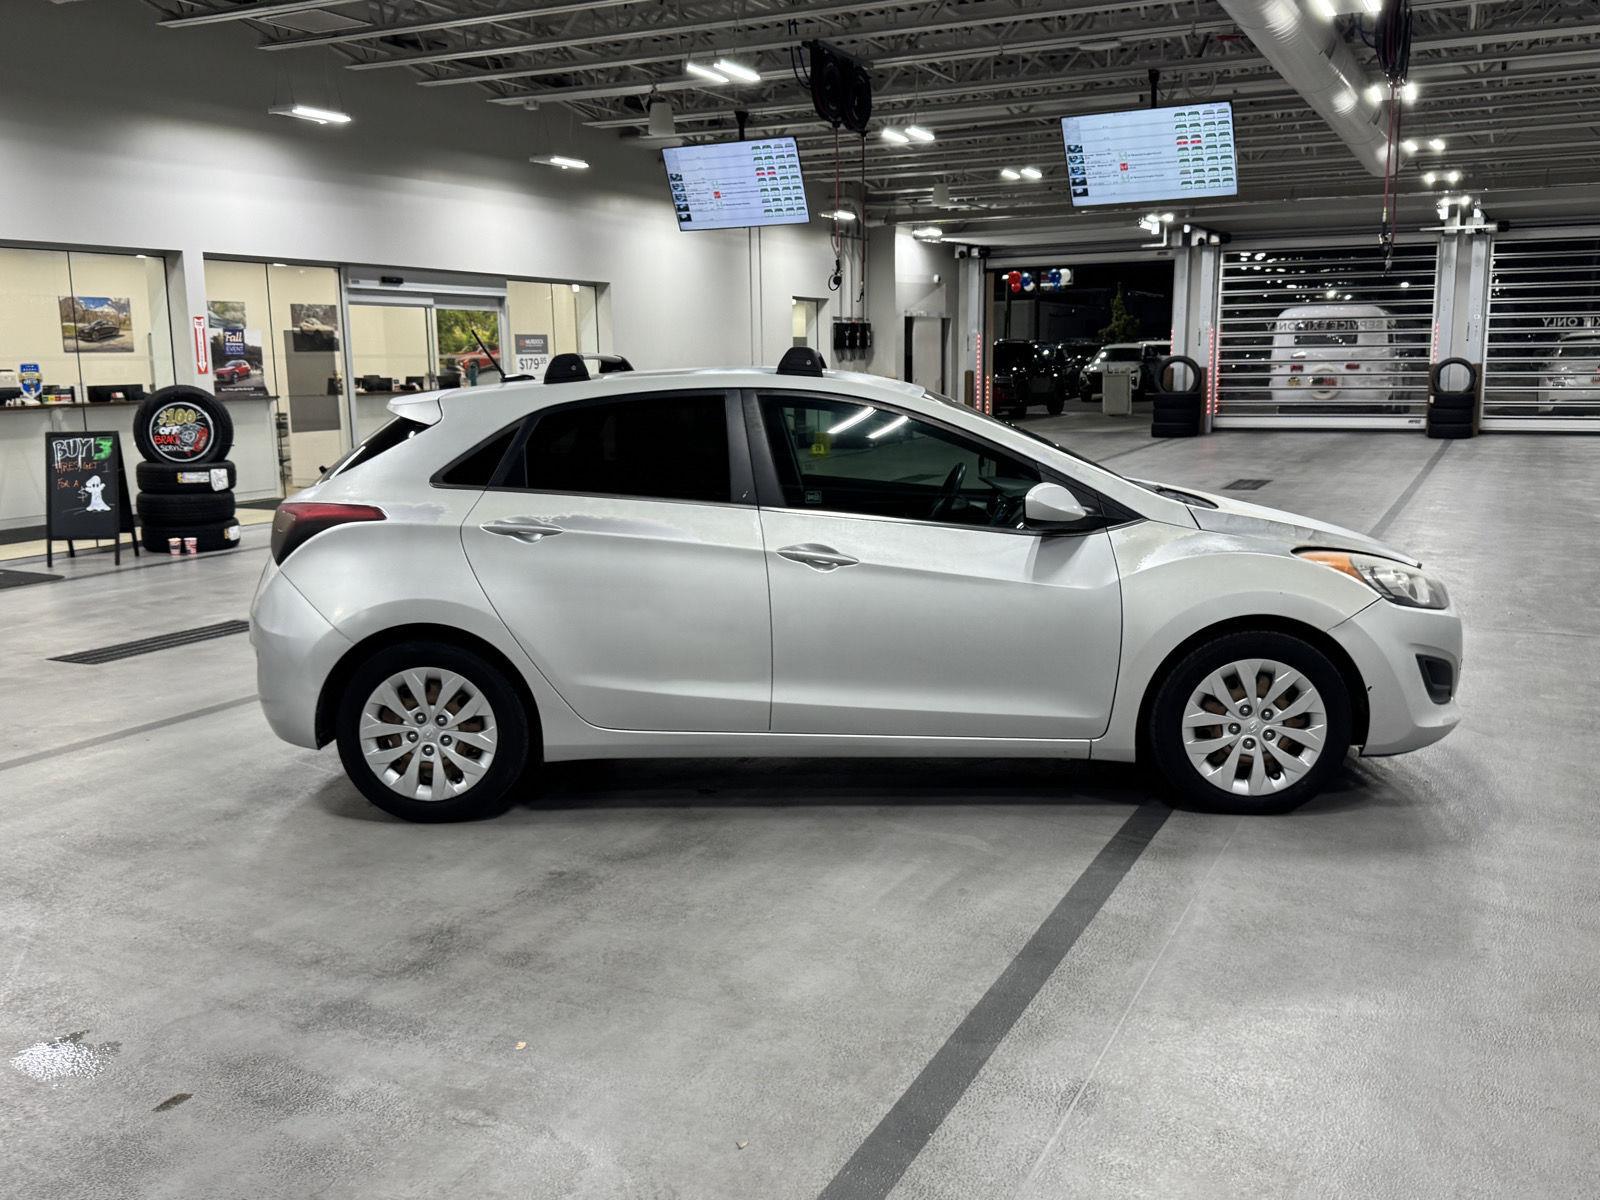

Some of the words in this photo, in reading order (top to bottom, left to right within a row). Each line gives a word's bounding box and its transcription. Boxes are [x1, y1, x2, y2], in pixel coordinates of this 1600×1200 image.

[224, 331, 243, 343] Fall
[158, 408, 197, 427] $100
[52, 437, 95, 464] BUY
[93, 436, 114, 460] 3
